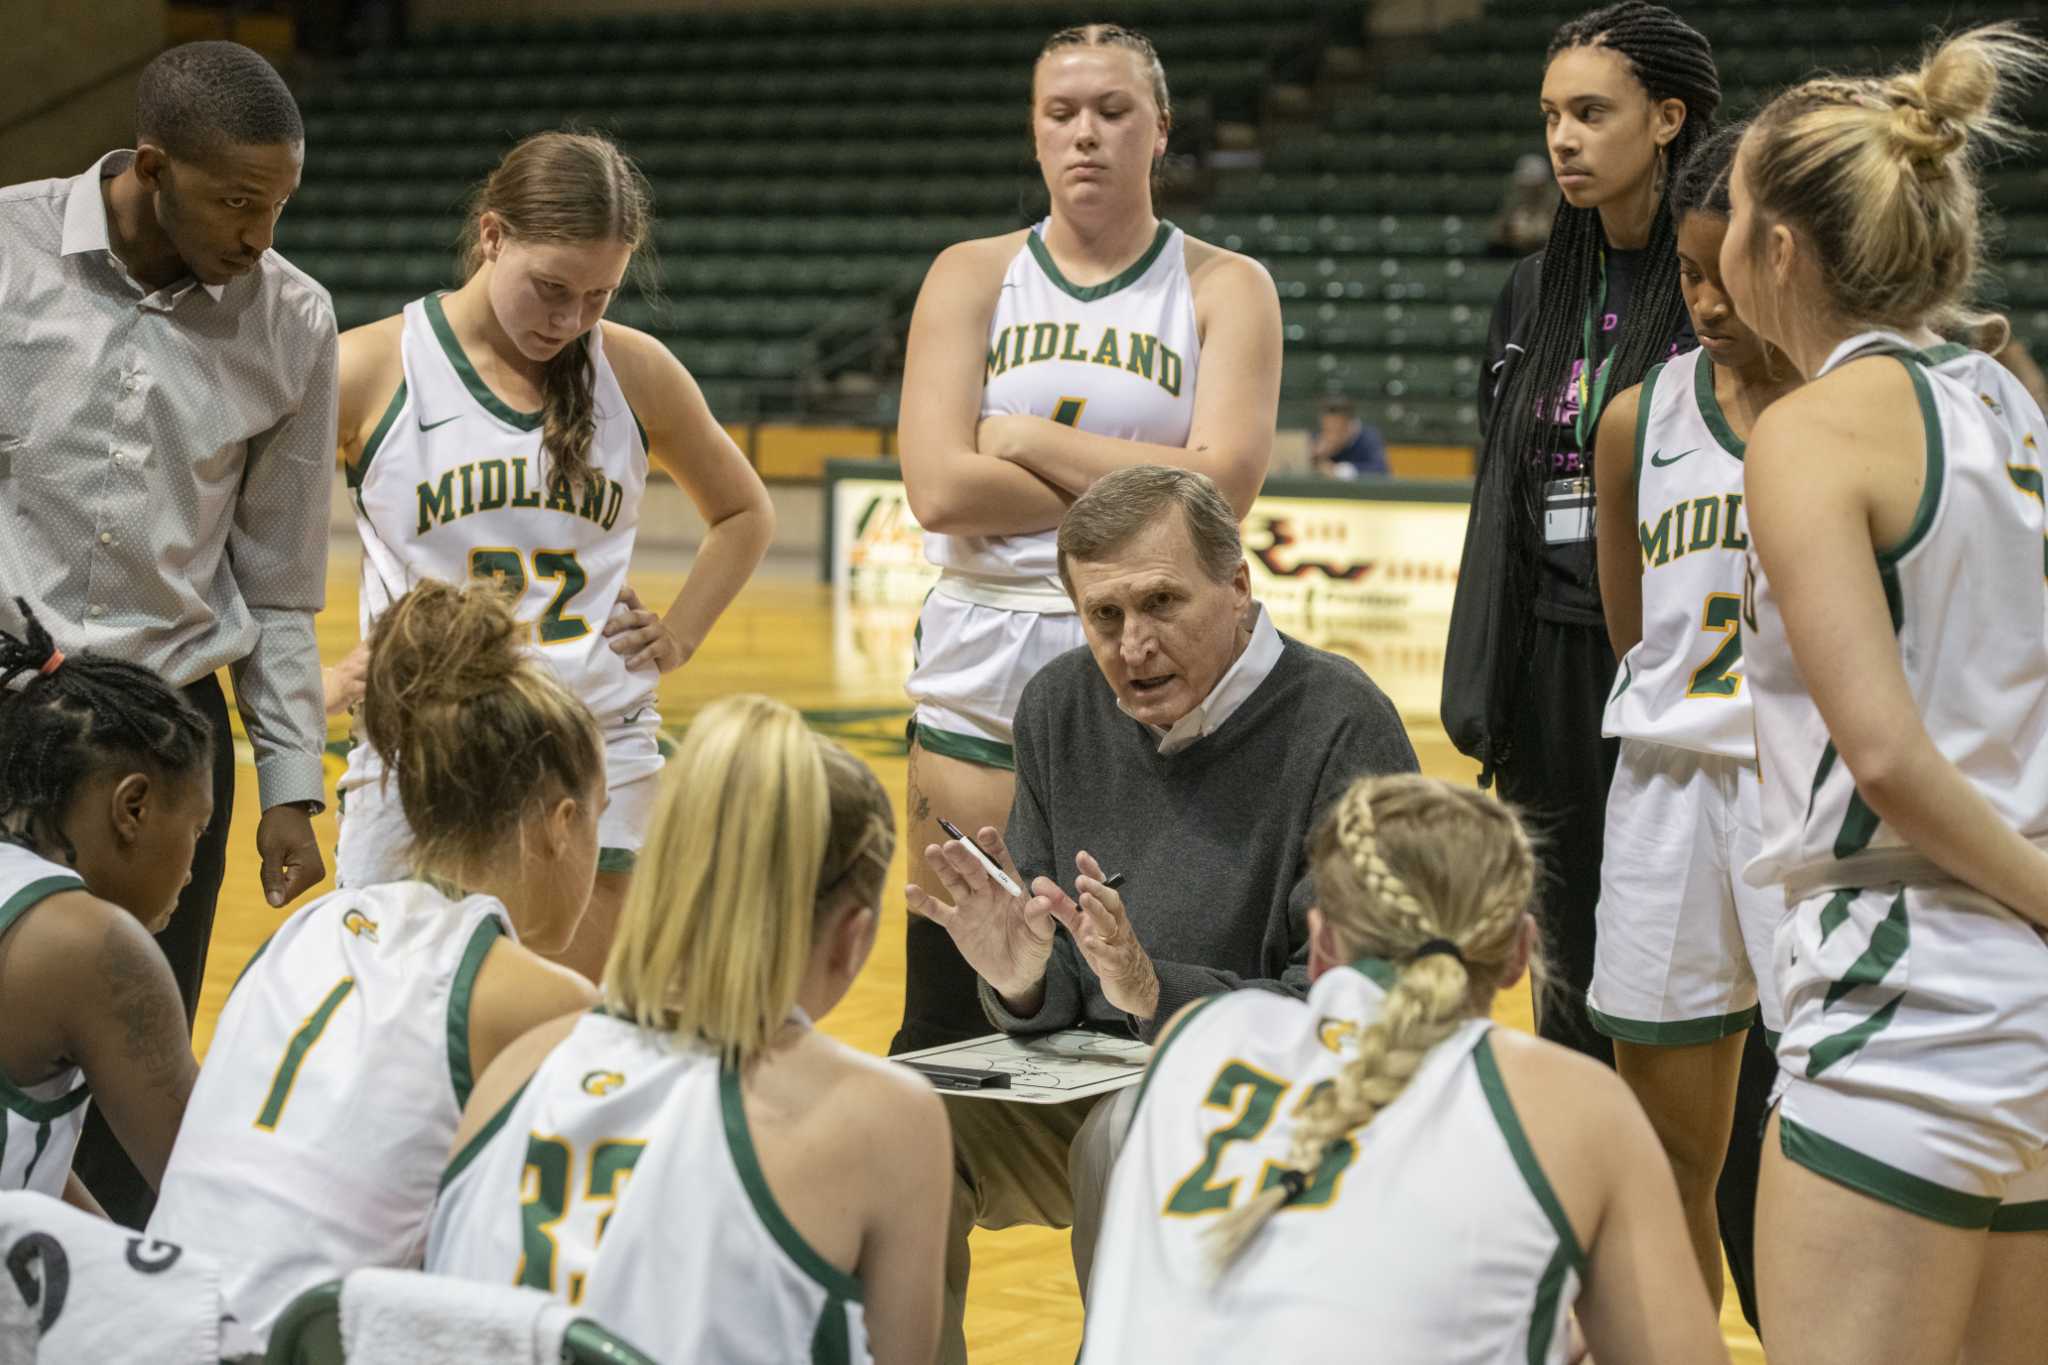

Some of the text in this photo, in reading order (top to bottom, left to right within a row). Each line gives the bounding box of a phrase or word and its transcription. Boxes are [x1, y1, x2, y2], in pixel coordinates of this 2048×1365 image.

[984, 321, 1183, 398] MIDLAND
[415, 456, 624, 537] MIDLAND
[468, 546, 593, 646] 22
[253, 974, 355, 1135] 1
